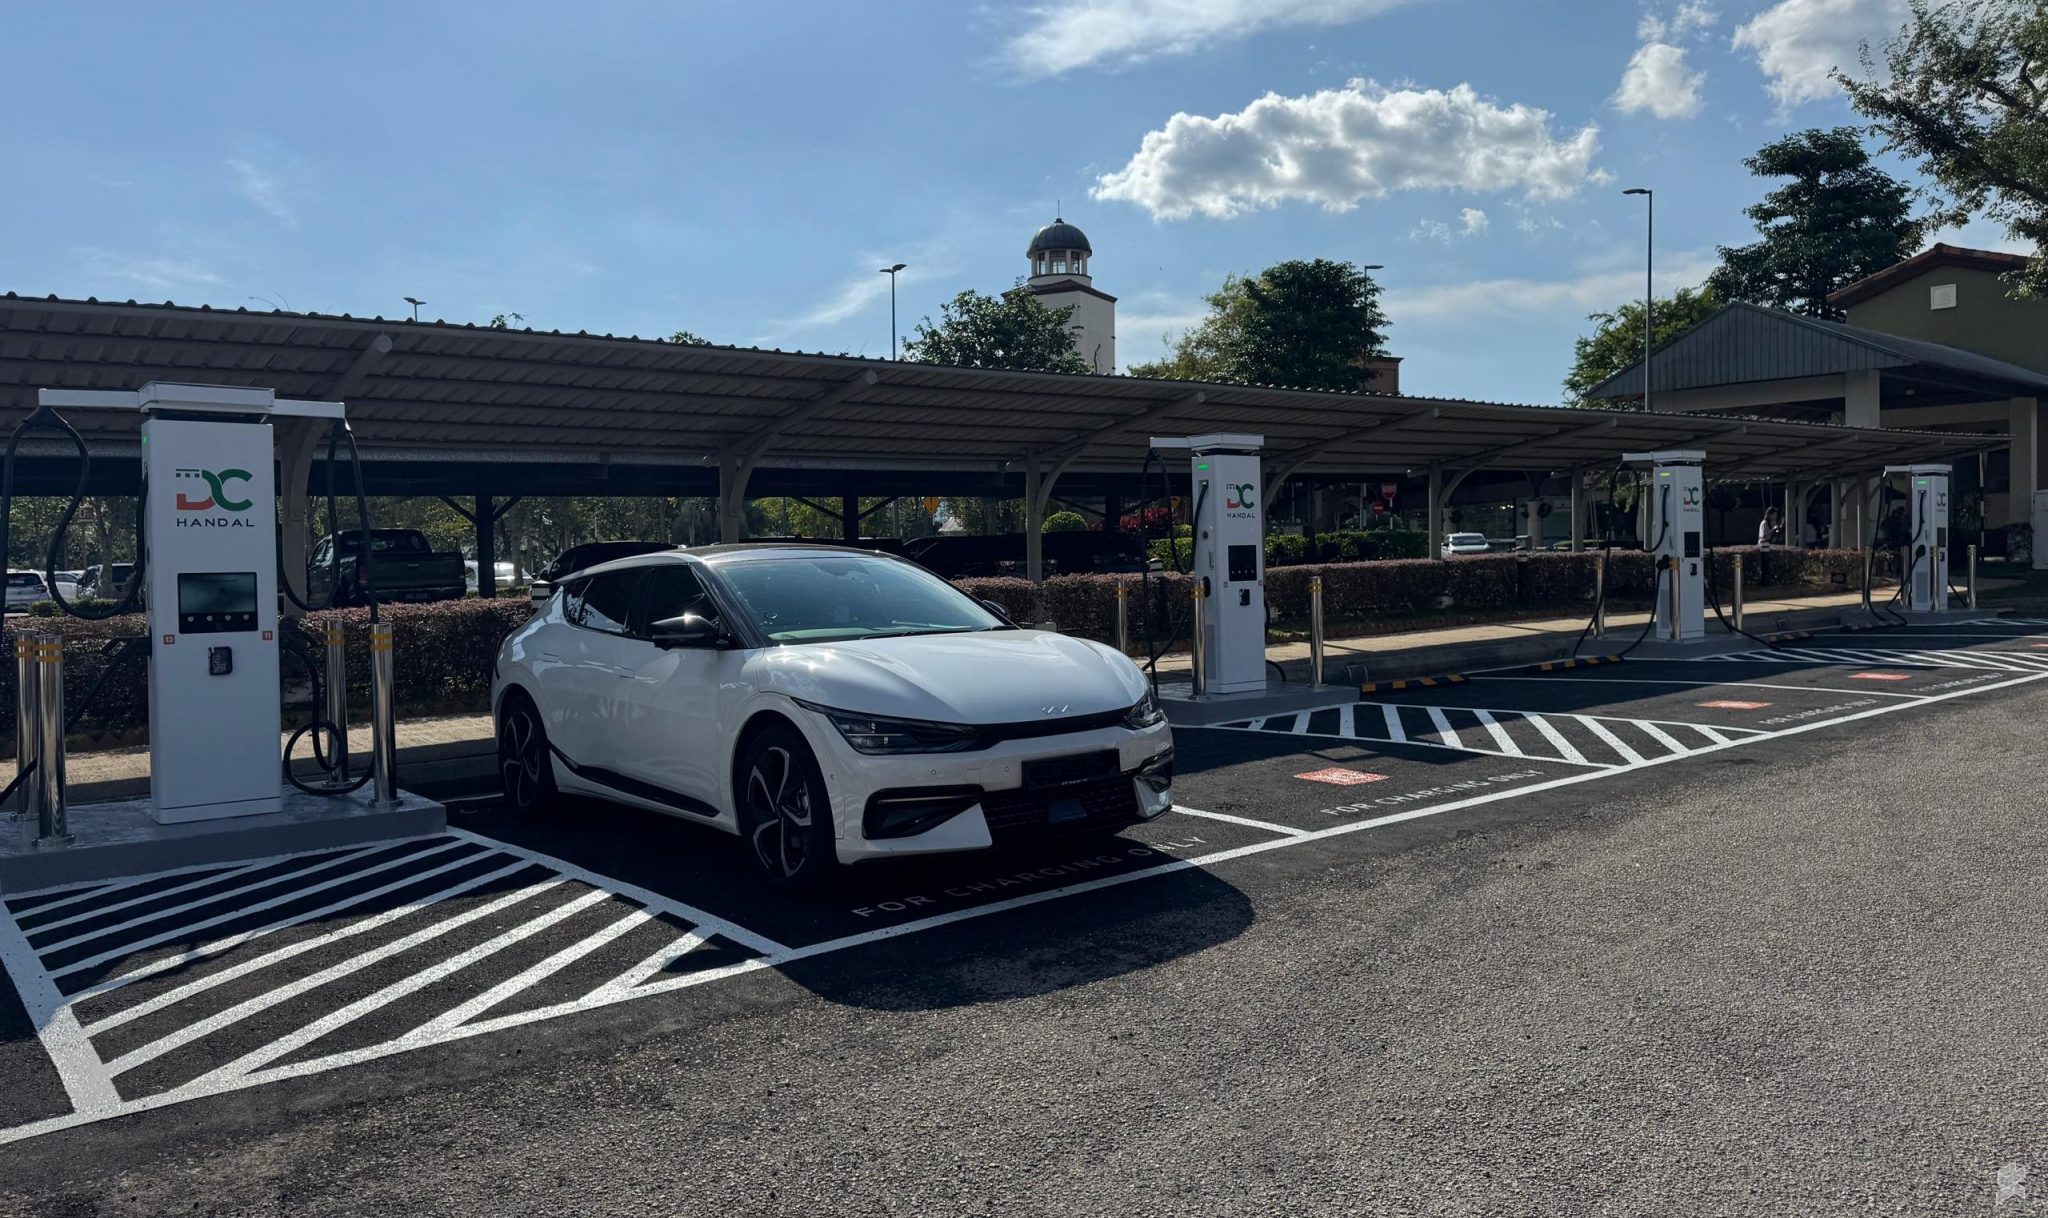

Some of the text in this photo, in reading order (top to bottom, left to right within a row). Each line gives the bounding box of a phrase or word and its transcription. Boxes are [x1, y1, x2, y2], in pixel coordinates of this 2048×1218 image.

[175, 468, 254, 512] DC
[1226, 483, 1255, 509] DC
[176, 518, 255, 527] HANDAL
[1320, 802, 1378, 816] FOR
[1375, 779, 1486, 806] CHARGING
[850, 836, 1207, 918] FOR CHARGING ONLY
